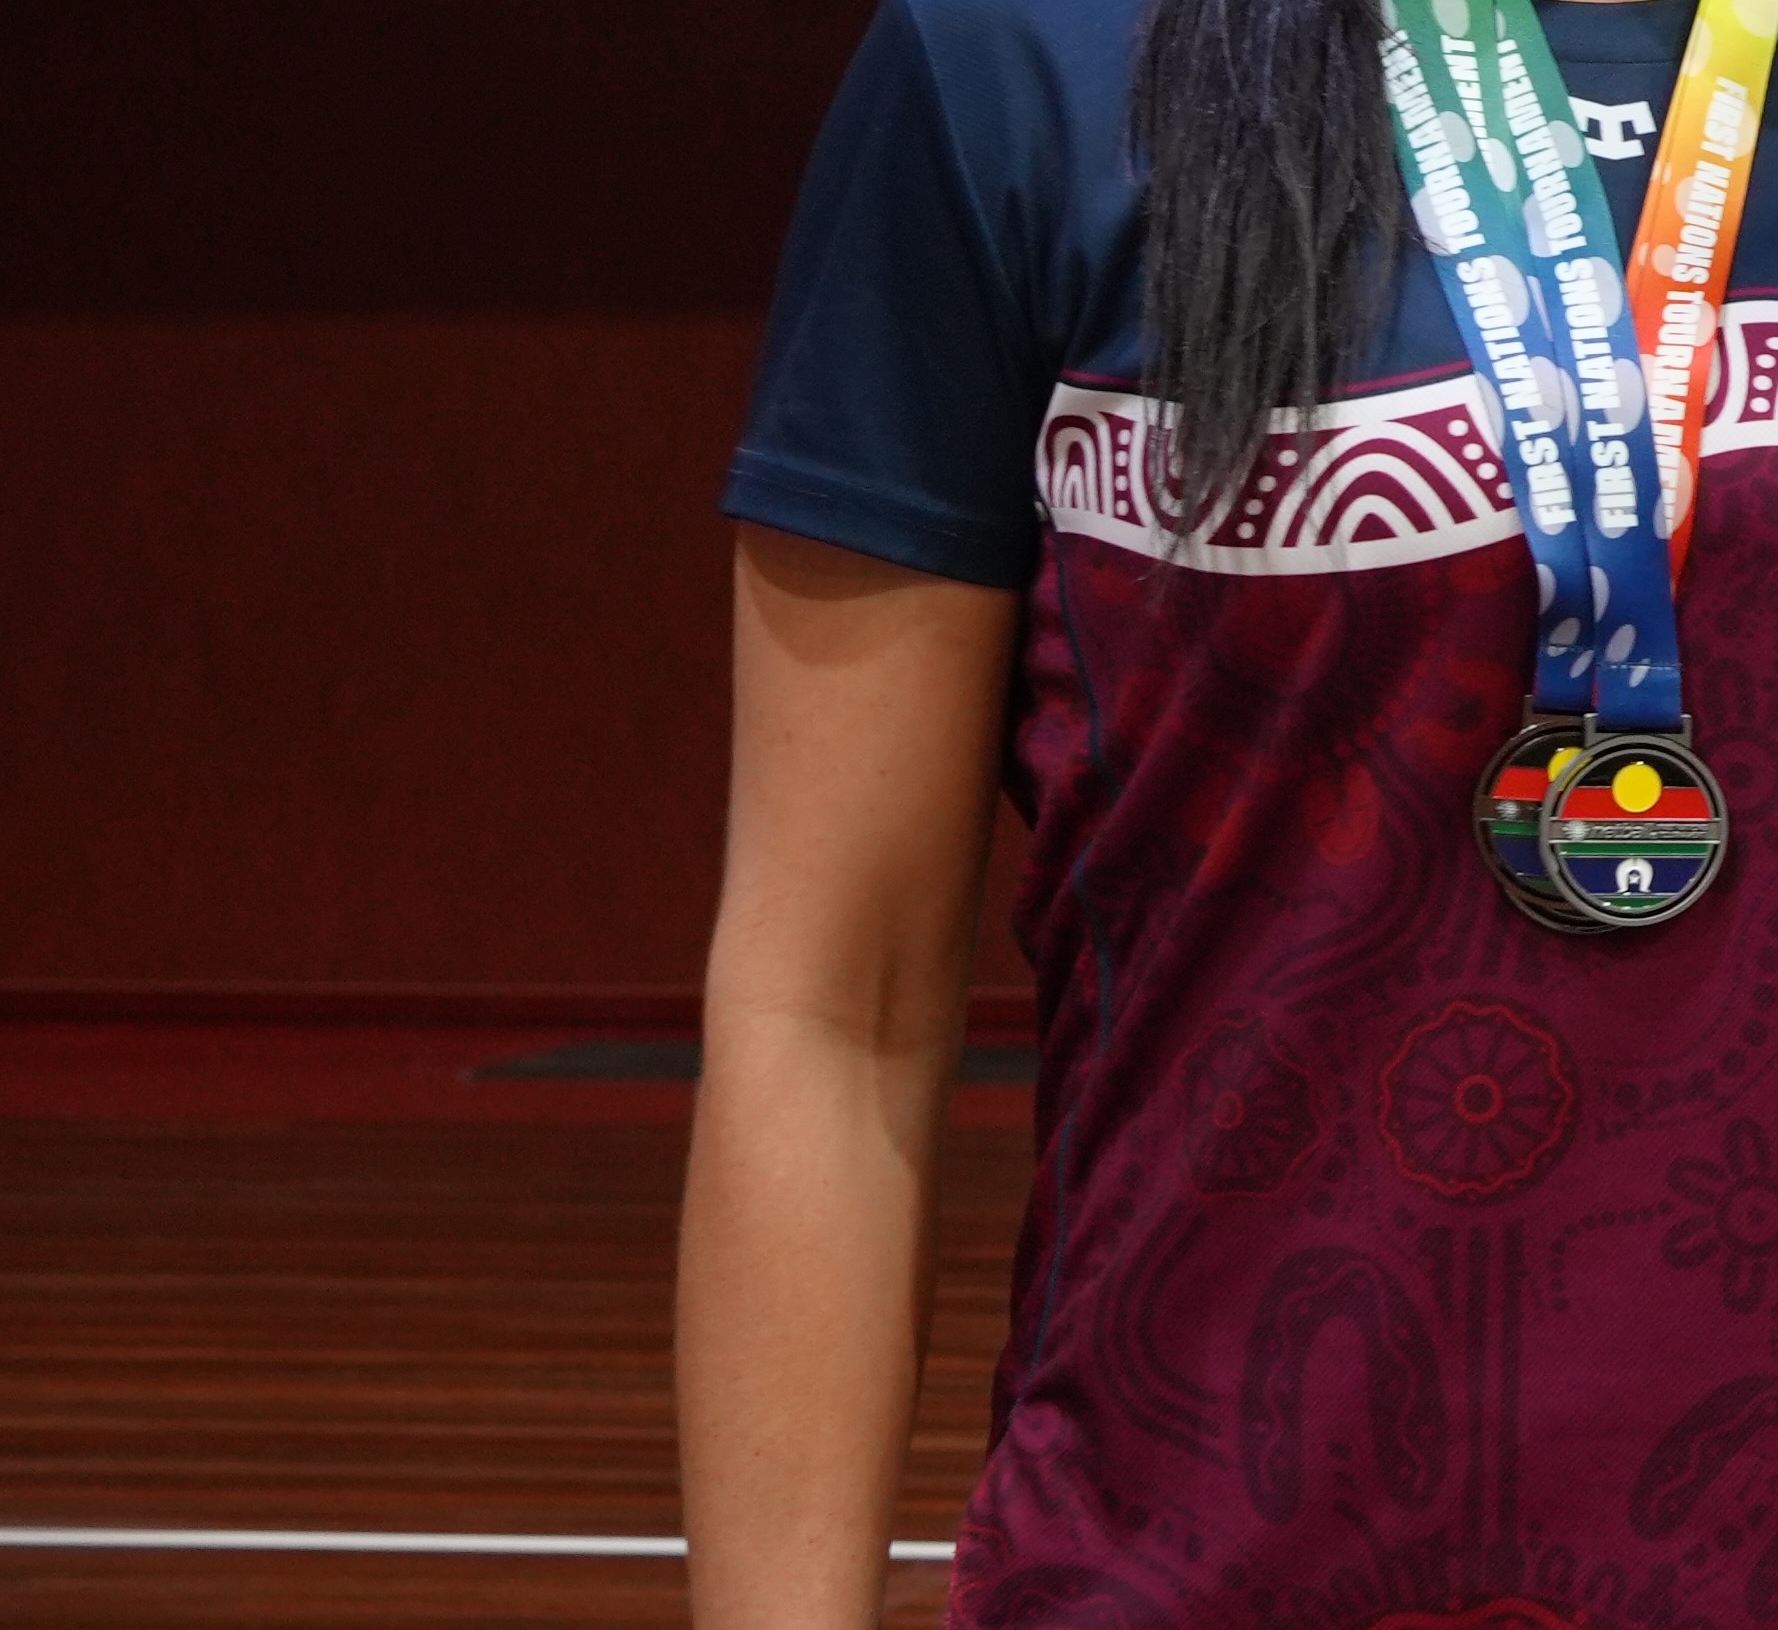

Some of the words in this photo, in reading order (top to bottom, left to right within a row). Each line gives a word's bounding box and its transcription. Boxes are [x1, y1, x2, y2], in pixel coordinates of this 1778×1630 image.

[1701, 76, 1749, 161] FIRST
[1671, 160, 1732, 285] NATIONS
[1457, 256, 1543, 411] NATIONS
[1554, 258, 1622, 411] NATIONS
[1511, 419, 1577, 526] FIRST
[1587, 421, 1640, 529] FIRST
